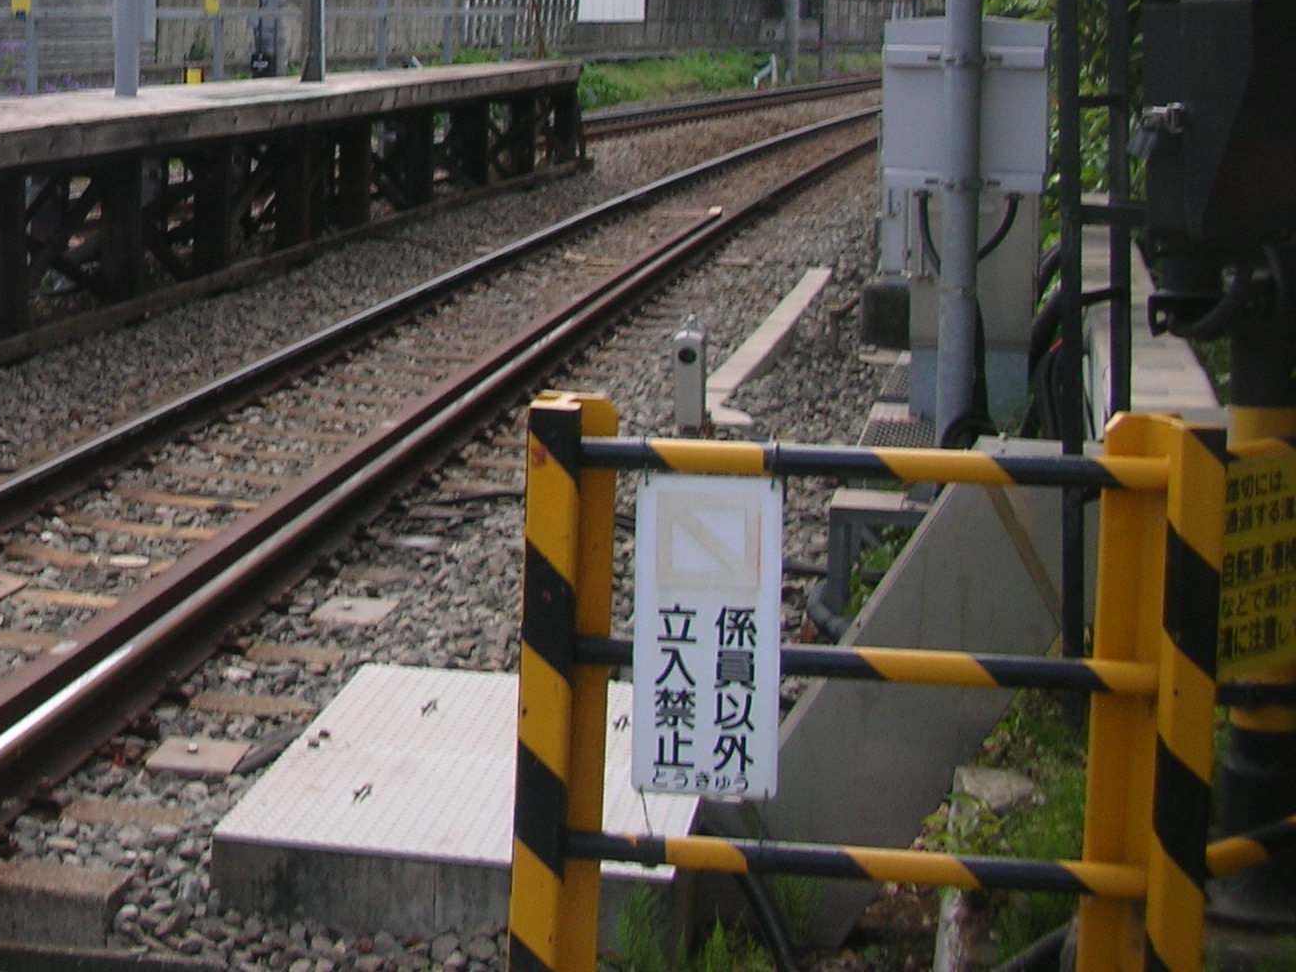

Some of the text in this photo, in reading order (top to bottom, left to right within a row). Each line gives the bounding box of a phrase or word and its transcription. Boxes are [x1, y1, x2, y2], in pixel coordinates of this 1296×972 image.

[653, 603, 697, 767] 立入禁止
[713, 604, 757, 771] 係員以外
[652, 769, 749, 791] とうきゅう
